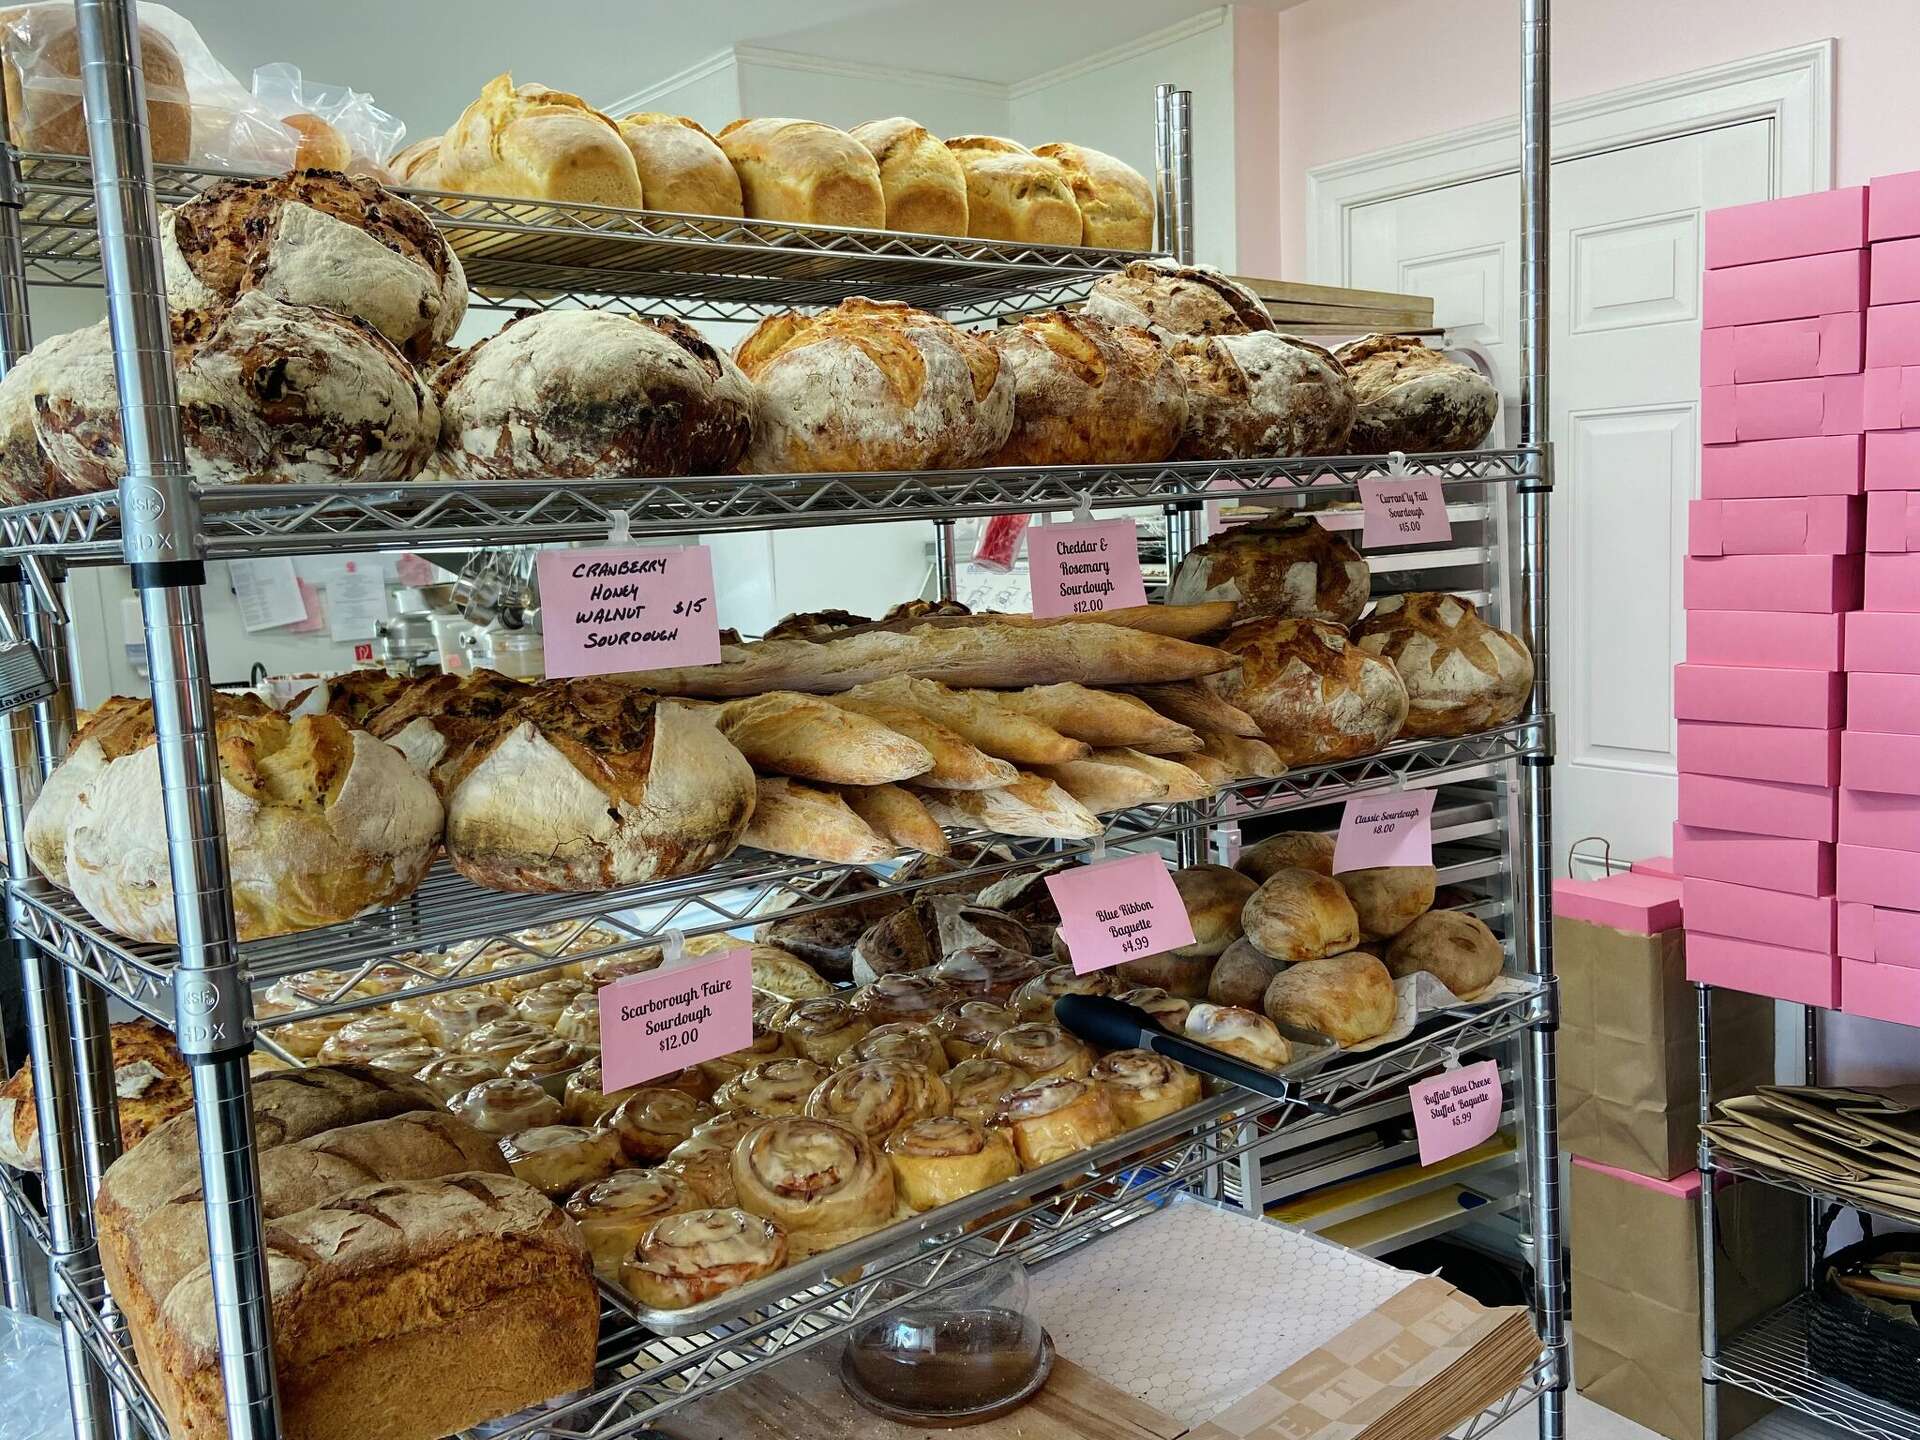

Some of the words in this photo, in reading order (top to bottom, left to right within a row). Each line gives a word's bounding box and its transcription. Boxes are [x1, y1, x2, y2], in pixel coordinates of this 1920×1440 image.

[1414, 491, 1428, 501] Fall
[1388, 507, 1424, 519] Sourdough
[1056, 540, 1097, 555] Cheddar
[1100, 538, 1108, 551] &
[572, 558, 667, 578] CRANBERRY
[1059, 561, 1110, 576] Rosemary
[591, 584, 639, 601] HONEY
[1060, 579, 1115, 597] Sourdough
[576, 606, 645, 624] WALNUT
[673, 598, 707, 617] $15
[1073, 599, 1103, 613] $12.00
[584, 628, 678, 649] SOURDOUGH
[0, 689, 41, 708] aster
[1355, 813, 1380, 824] Classic
[1381, 808, 1419, 821] Sourdough
[1373, 823, 1395, 834] $8.00
[1096, 909, 1120, 923] Blue
[1119, 901, 1154, 917] Ribbon
[1108, 919, 1152, 938] Baguette
[1122, 936, 1149, 953] $4.99
[621, 987, 700, 1022] Scarborough
[700, 979, 732, 998] Faire
[645, 1005, 712, 1036] Sourdough
[659, 1028, 699, 1053] $12.00
[1424, 1091, 1450, 1106] Buffalo
[1468, 1077, 1492, 1091] Cheese
[1430, 1103, 1456, 1120] Stuffed
[1457, 1093, 1489, 1110] Baguette
[1452, 1111, 1472, 1126] $5.99
